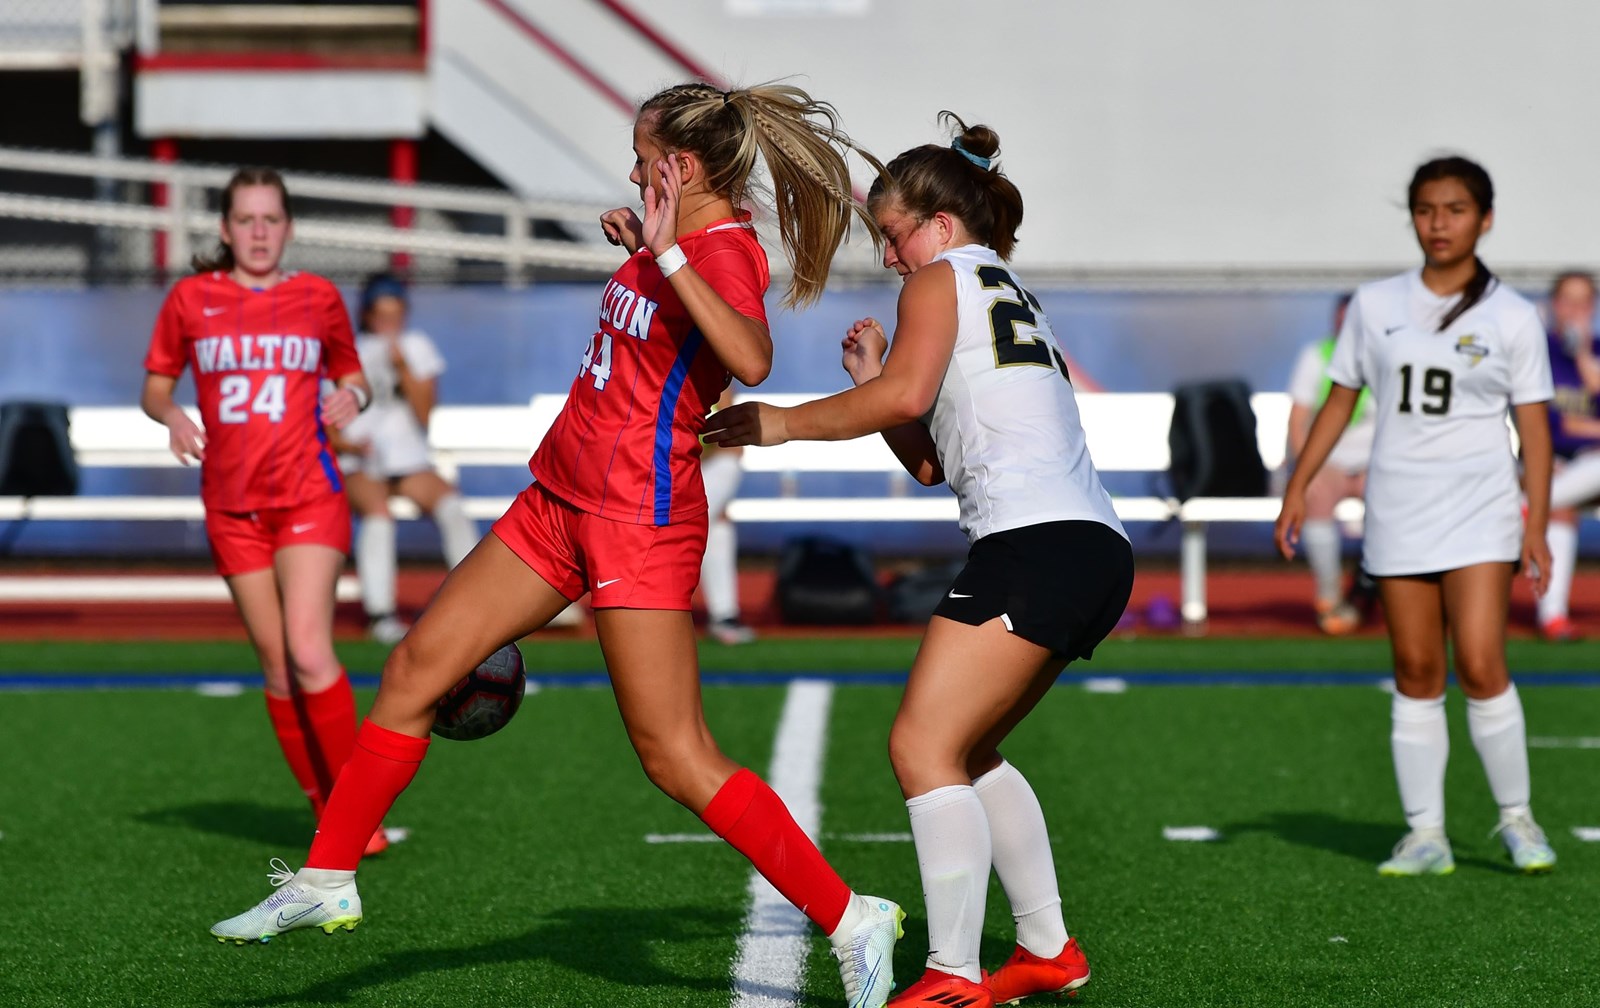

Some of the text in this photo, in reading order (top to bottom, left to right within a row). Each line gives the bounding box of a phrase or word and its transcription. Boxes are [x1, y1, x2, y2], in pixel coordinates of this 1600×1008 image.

[974, 264, 1072, 388] 2
[194, 334, 321, 374] WALTON
[219, 373, 286, 424] 24
[1398, 364, 1454, 416] 19
